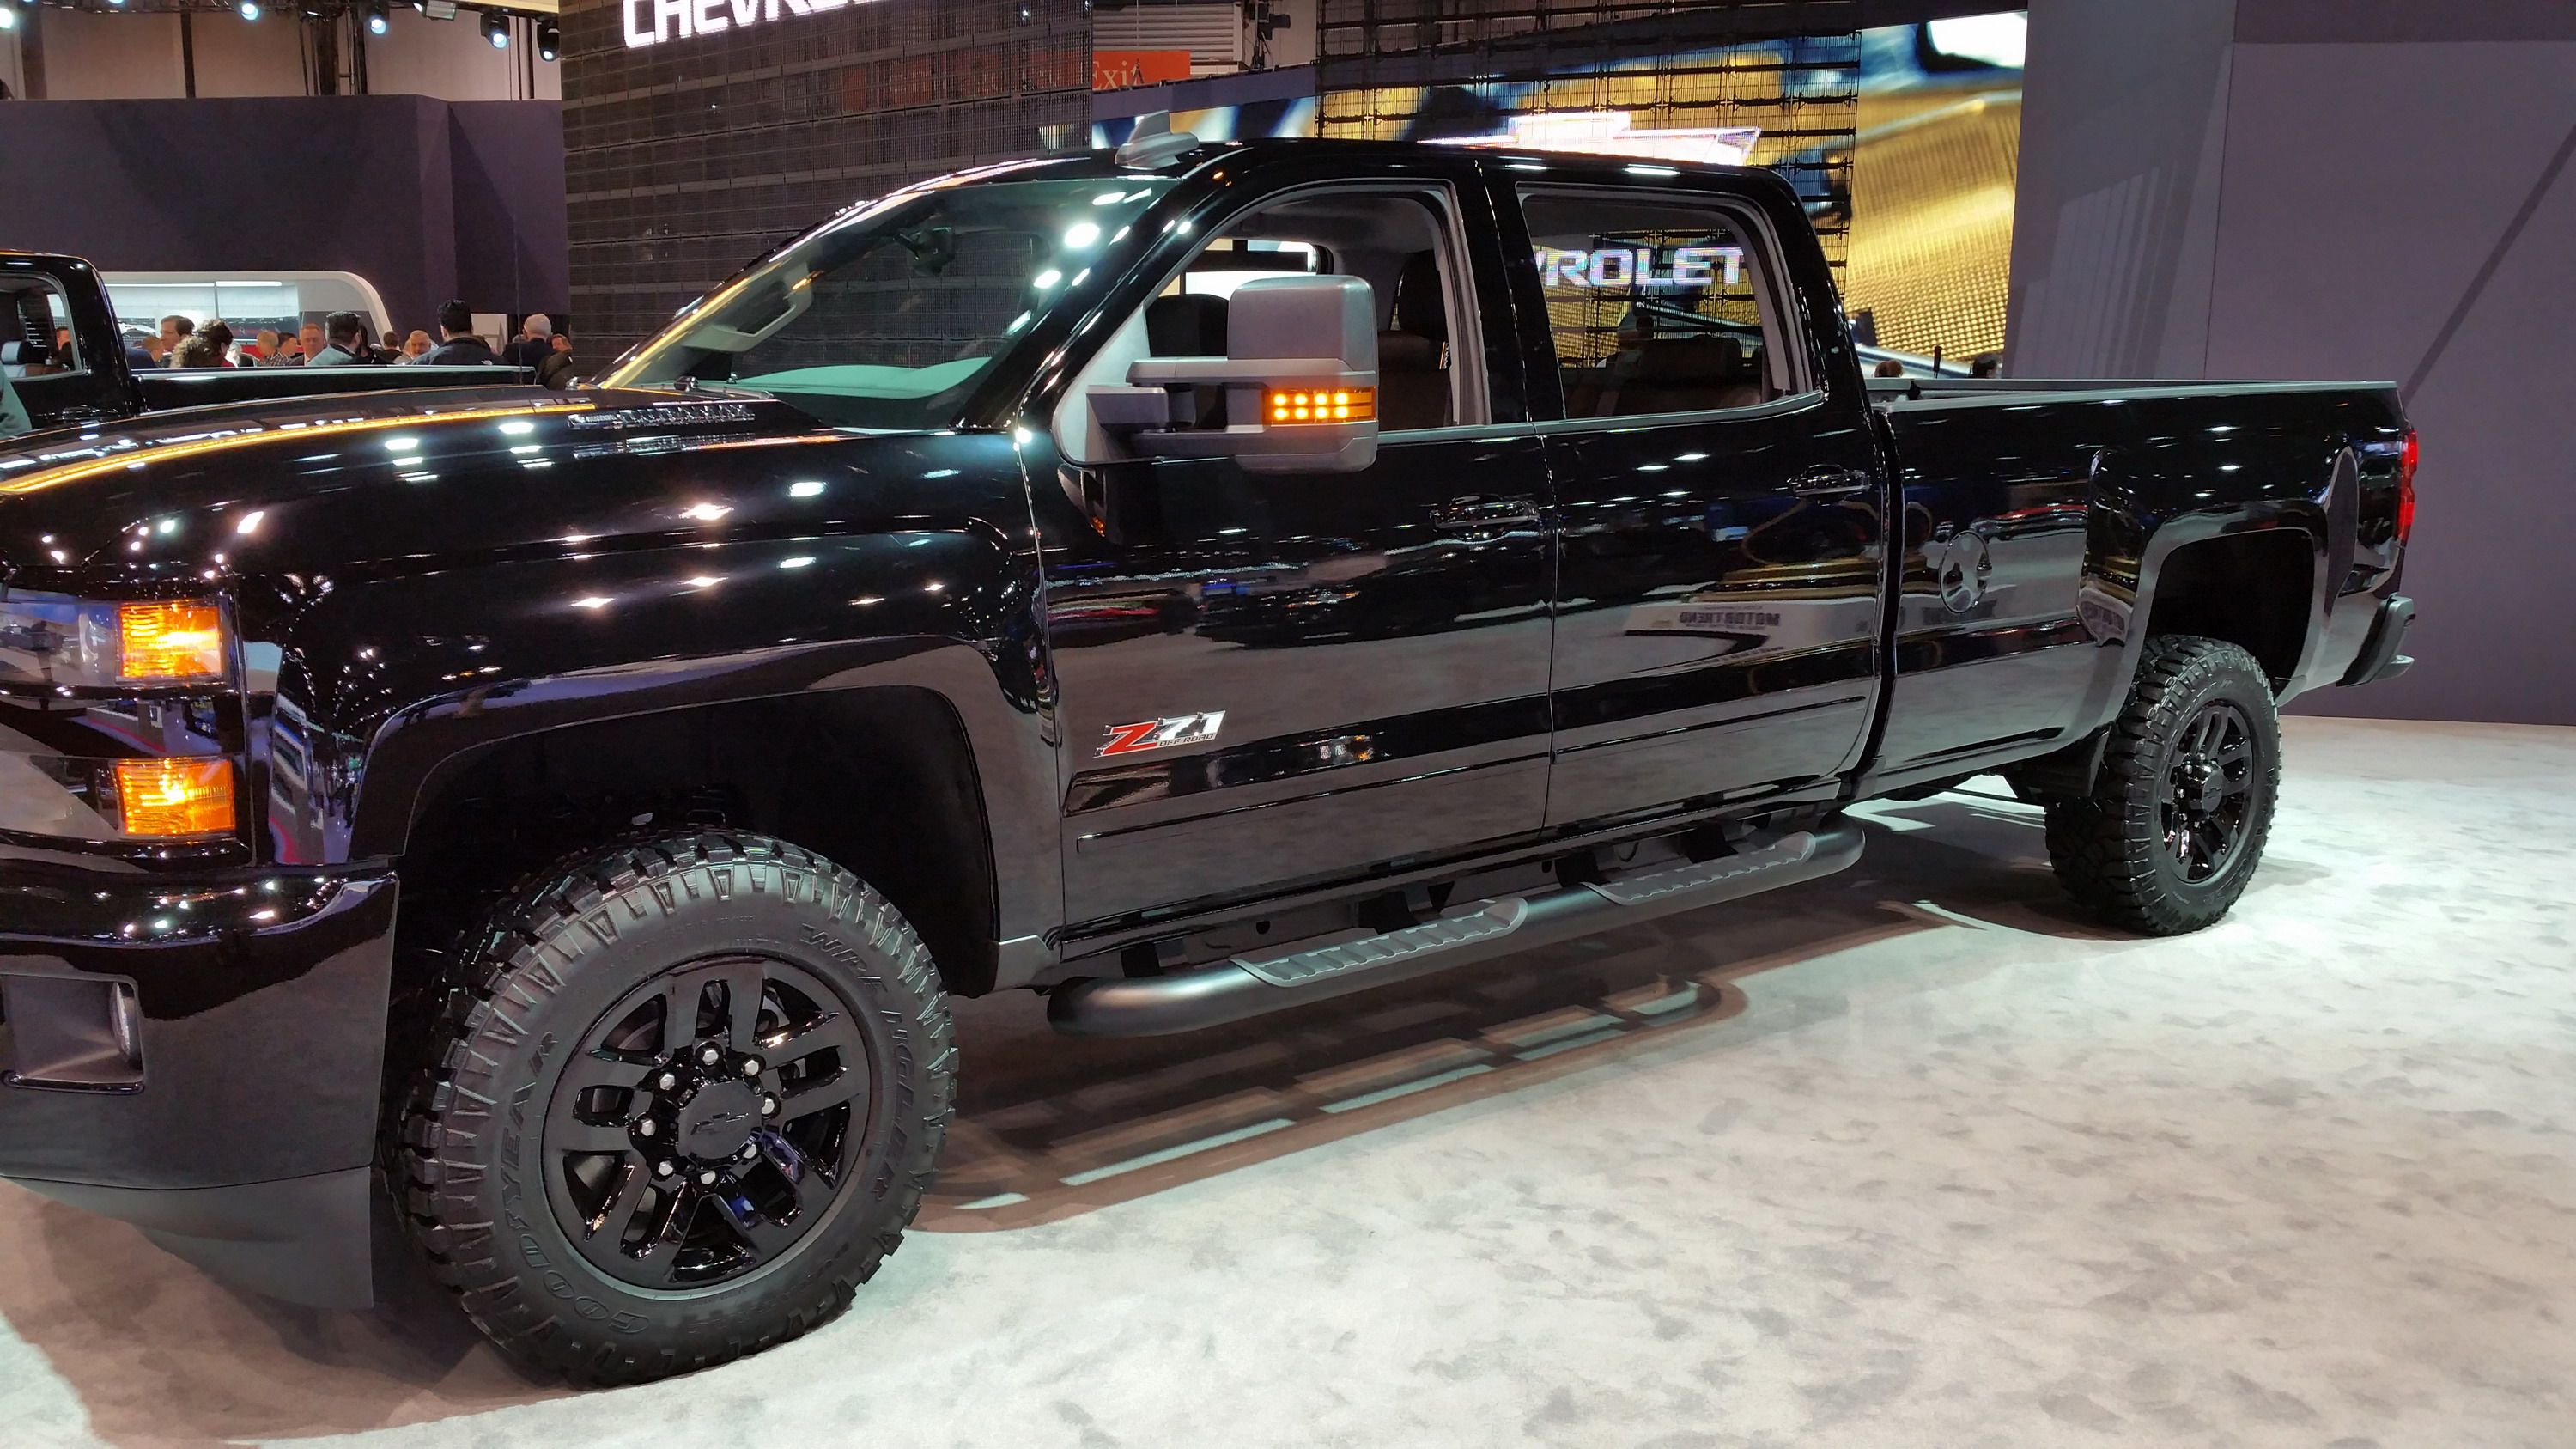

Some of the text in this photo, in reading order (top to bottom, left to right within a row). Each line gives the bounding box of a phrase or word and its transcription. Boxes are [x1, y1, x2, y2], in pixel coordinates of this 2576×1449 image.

[1536, 247, 1743, 286] ROLET
[1093, 710, 1226, 758] Z71
[1159, 733, 1214, 747] OFF ROAD
[501, 1031, 650, 1334] GOODYEAR
